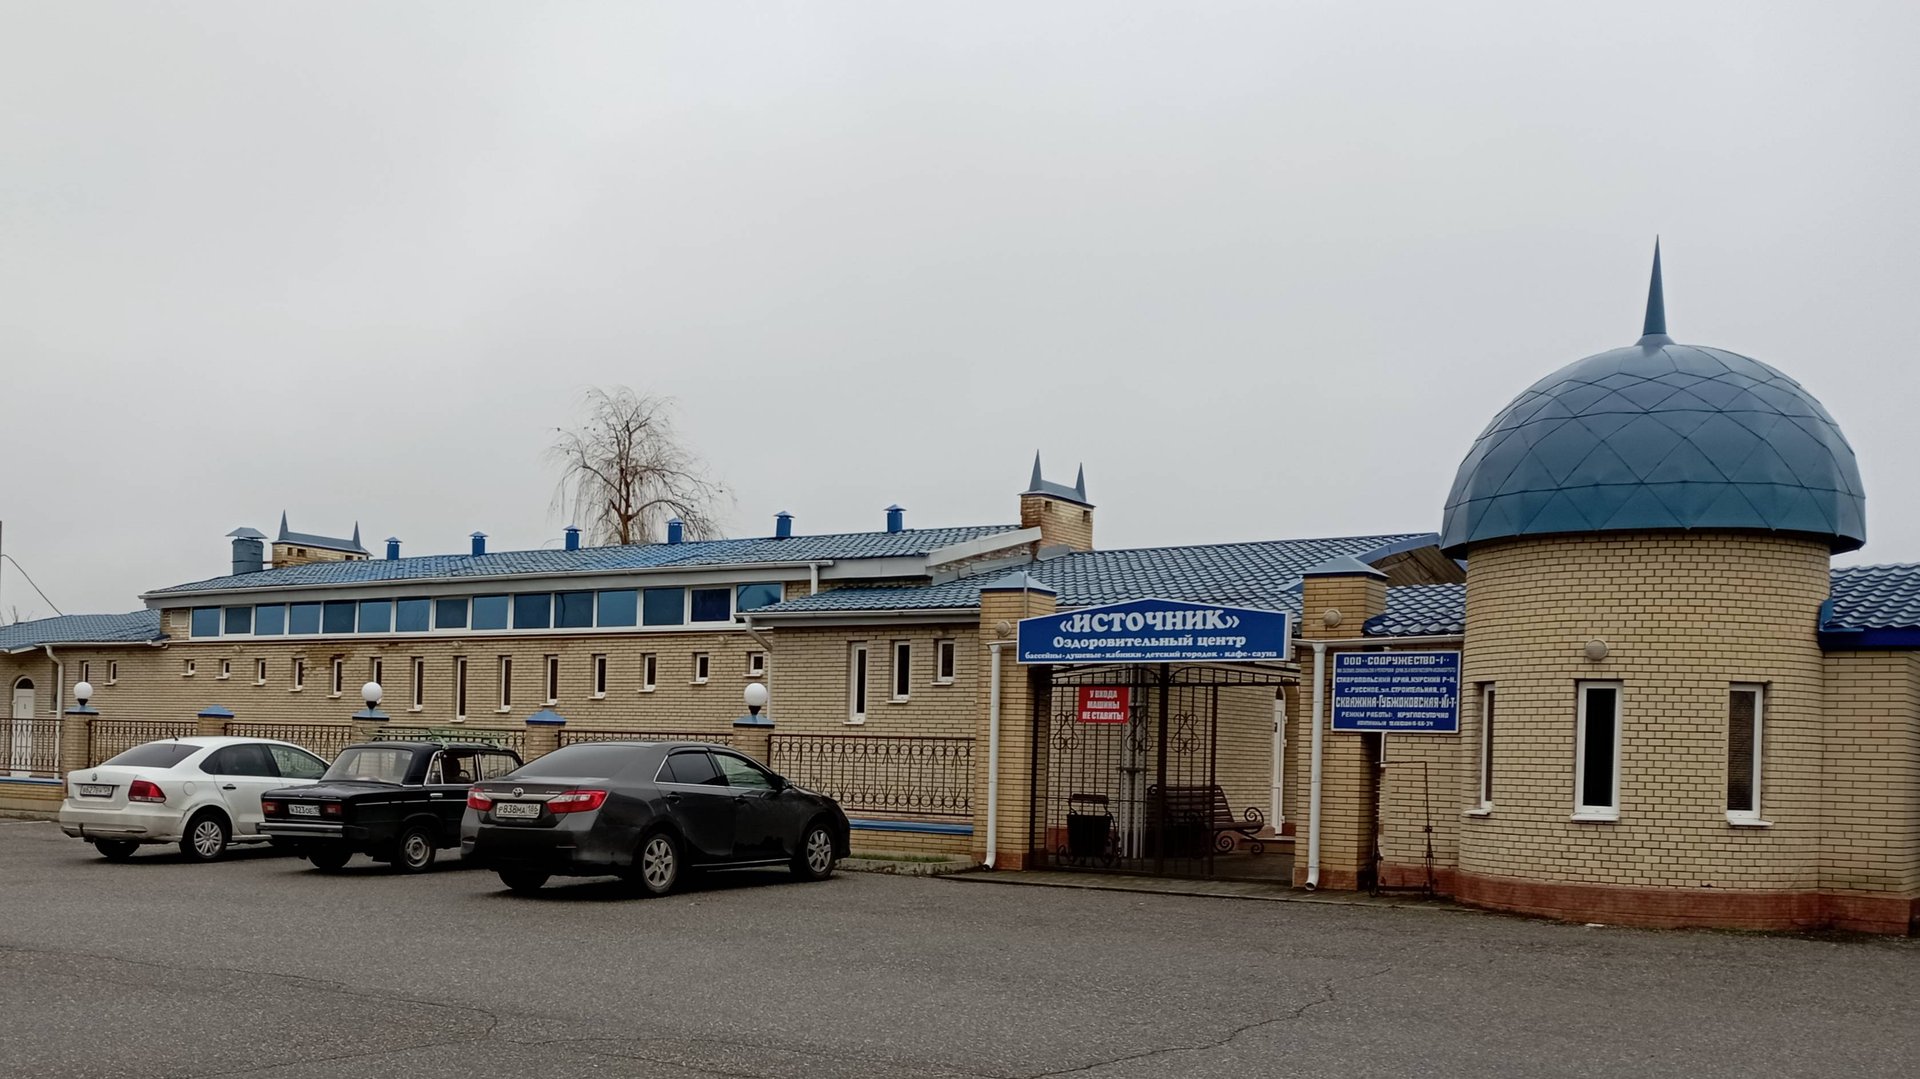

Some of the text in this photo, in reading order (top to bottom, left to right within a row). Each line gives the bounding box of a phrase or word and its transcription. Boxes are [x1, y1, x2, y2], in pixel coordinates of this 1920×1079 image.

[1060, 610, 1240, 632] «ИСТОЧНИК»
[1053, 634, 1246, 649] Оздоровительный центр
[1105, 650, 1141, 658] кабинки
[1182, 651, 1218, 659] городок
[1224, 650, 1248, 658] кафе
[1343, 656, 1362, 665] ООО
[1087, 701, 1120, 709] МАШИНЫ
[1082, 711, 1091, 719] НЕ
